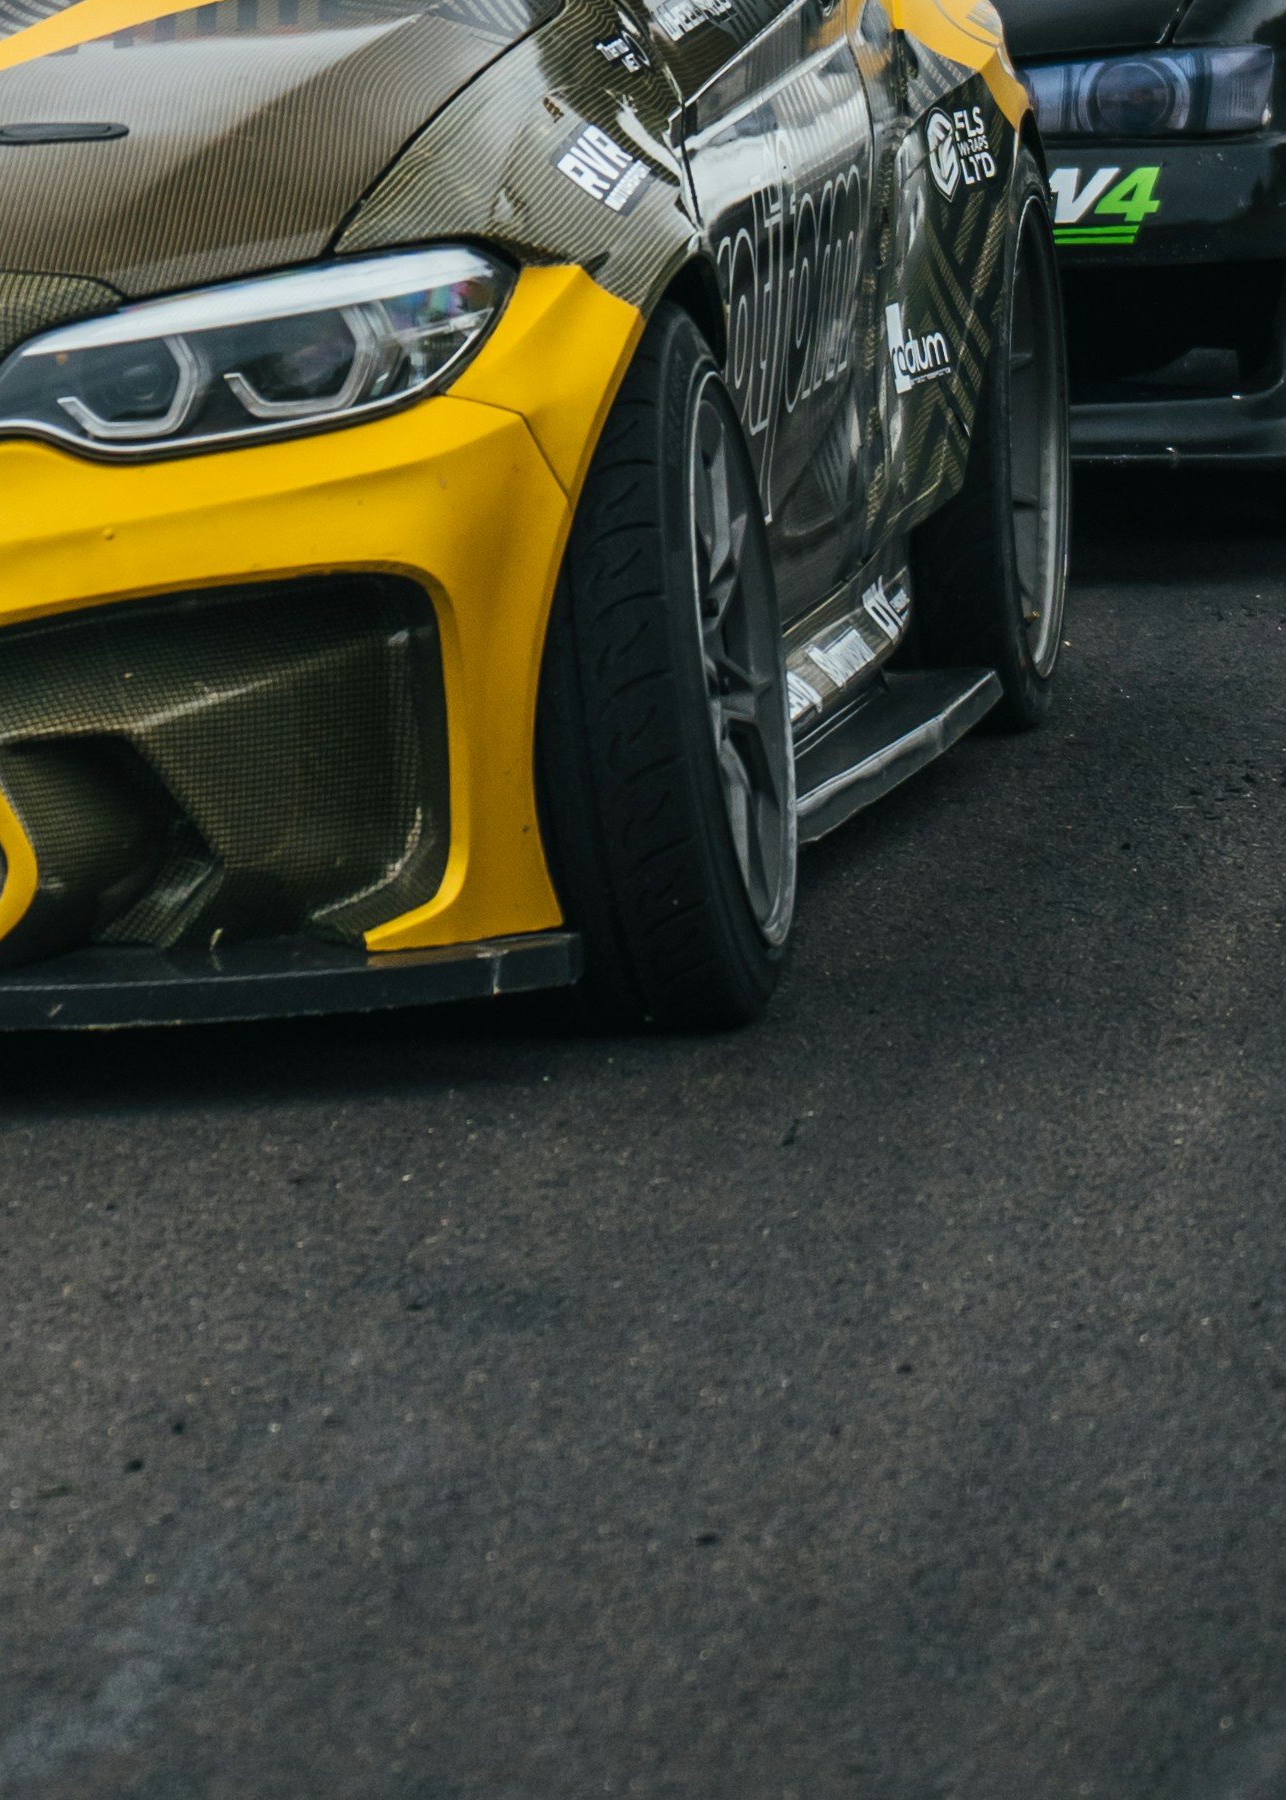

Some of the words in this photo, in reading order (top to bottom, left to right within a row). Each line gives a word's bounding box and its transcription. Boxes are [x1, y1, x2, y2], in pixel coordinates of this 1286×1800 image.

[953, 106, 985, 142] FLS
[557, 124, 633, 200] RVR
[960, 152, 998, 186] LTD
